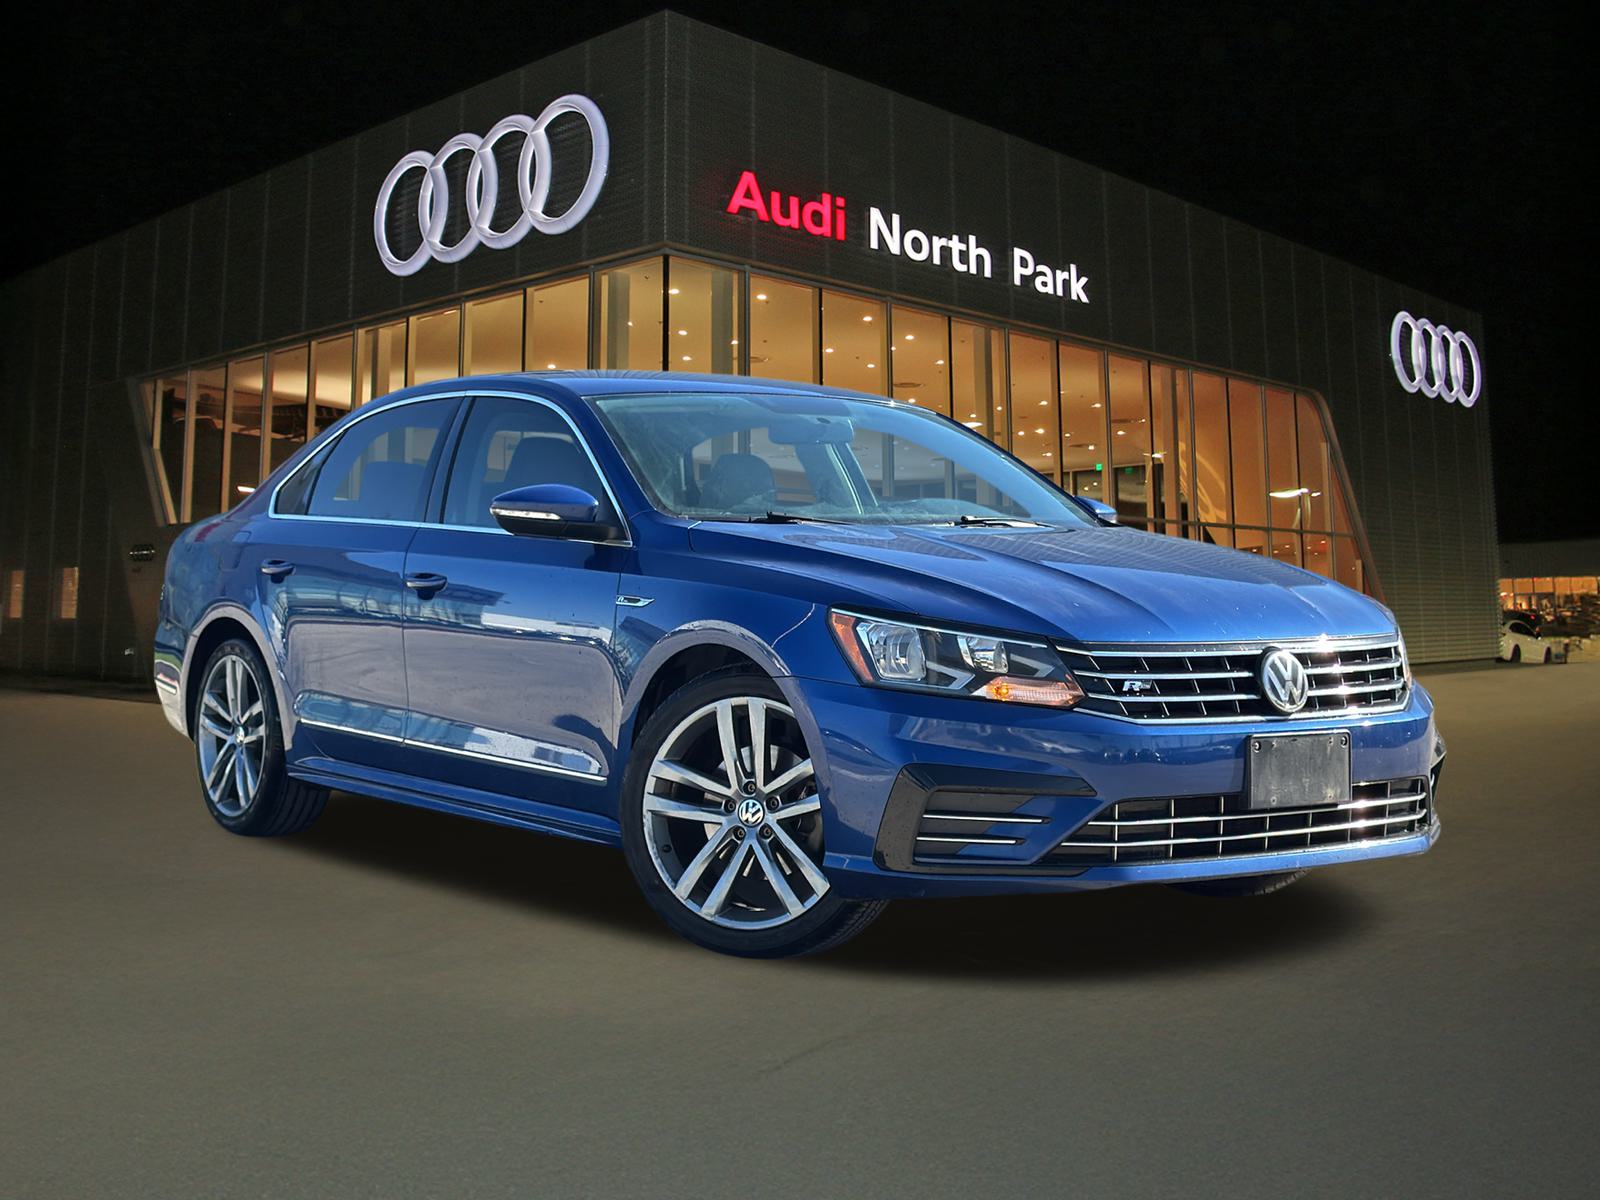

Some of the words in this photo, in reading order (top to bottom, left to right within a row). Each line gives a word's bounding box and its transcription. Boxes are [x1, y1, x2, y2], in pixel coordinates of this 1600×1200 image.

[726, 170, 846, 241] Audi
[869, 206, 992, 278] North
[1013, 247, 1090, 303] Park
